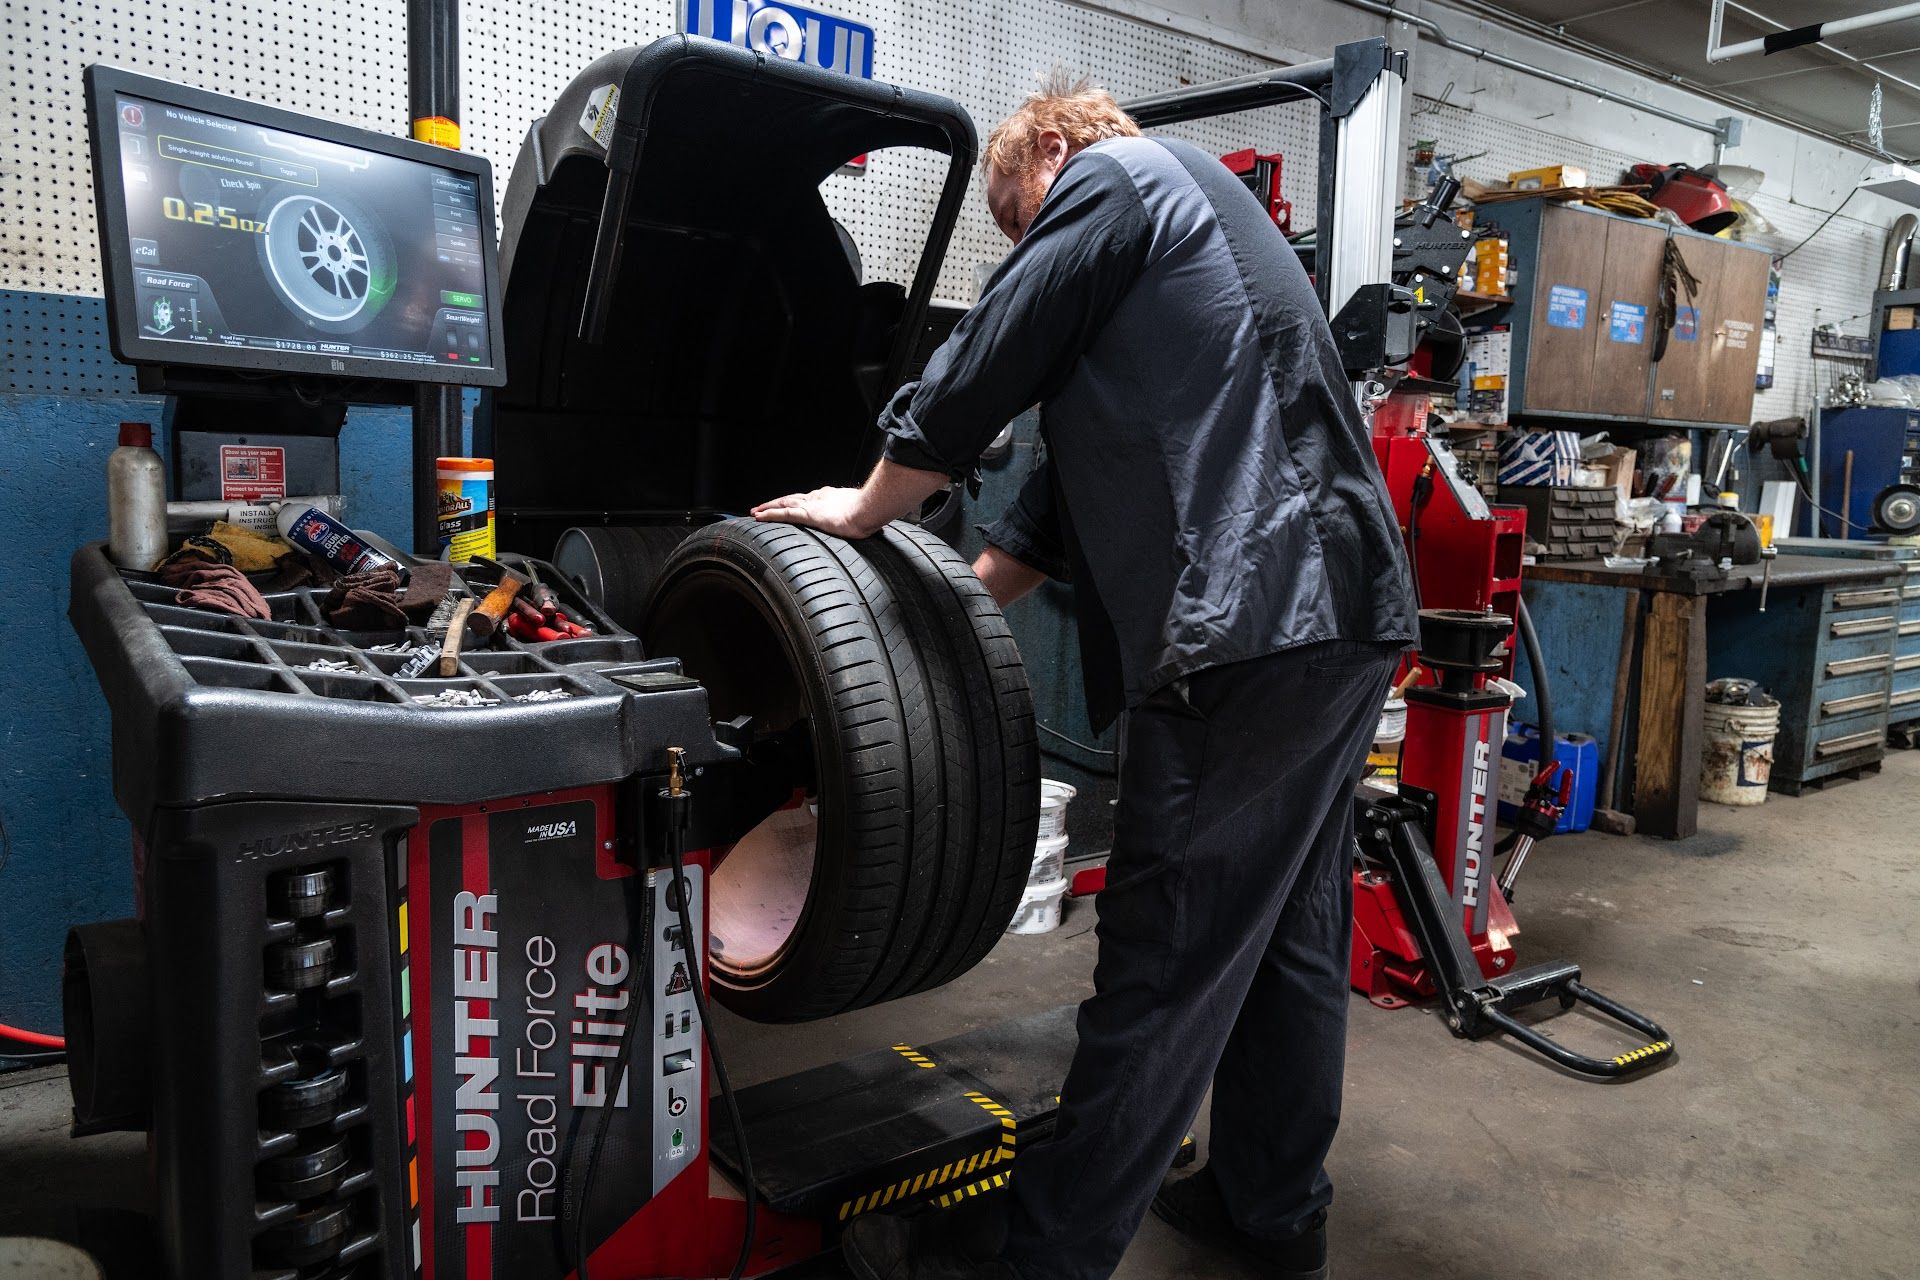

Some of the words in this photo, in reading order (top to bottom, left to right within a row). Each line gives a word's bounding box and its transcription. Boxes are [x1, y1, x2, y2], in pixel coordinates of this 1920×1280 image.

[166, 110, 177, 119] No
[178, 112, 205, 126] Vehicle
[206, 119, 237, 132] Selected
[168, 144, 210, 159] Single-weight
[211, 152, 235, 163] solution
[220, 178, 244, 189] Check
[245, 180, 261, 190] Spin
[135, 246, 156, 257] eCal
[1415, 242, 1468, 250] HUNTER
[146, 276, 167, 286] Road
[169, 279, 191, 289] Force
[452, 295, 472, 304] SERVO
[446, 313, 480, 324] SmartWeight
[320, 343, 350, 351] HUNTER
[440, 520, 461, 531] Glass
[324, 533, 341, 550] GUM
[325, 533, 352, 560] CUTTER
[528, 824, 549, 834] MADE
[548, 820, 577, 837] USA
[1463, 740, 1490, 907] HUNTER
[235, 820, 375, 863] HUNTER
[517, 935, 557, 1078] Force
[572, 942, 630, 1108] Elite
[454, 890, 500, 1224] HUNTER
[517, 1092, 557, 1222] Road
